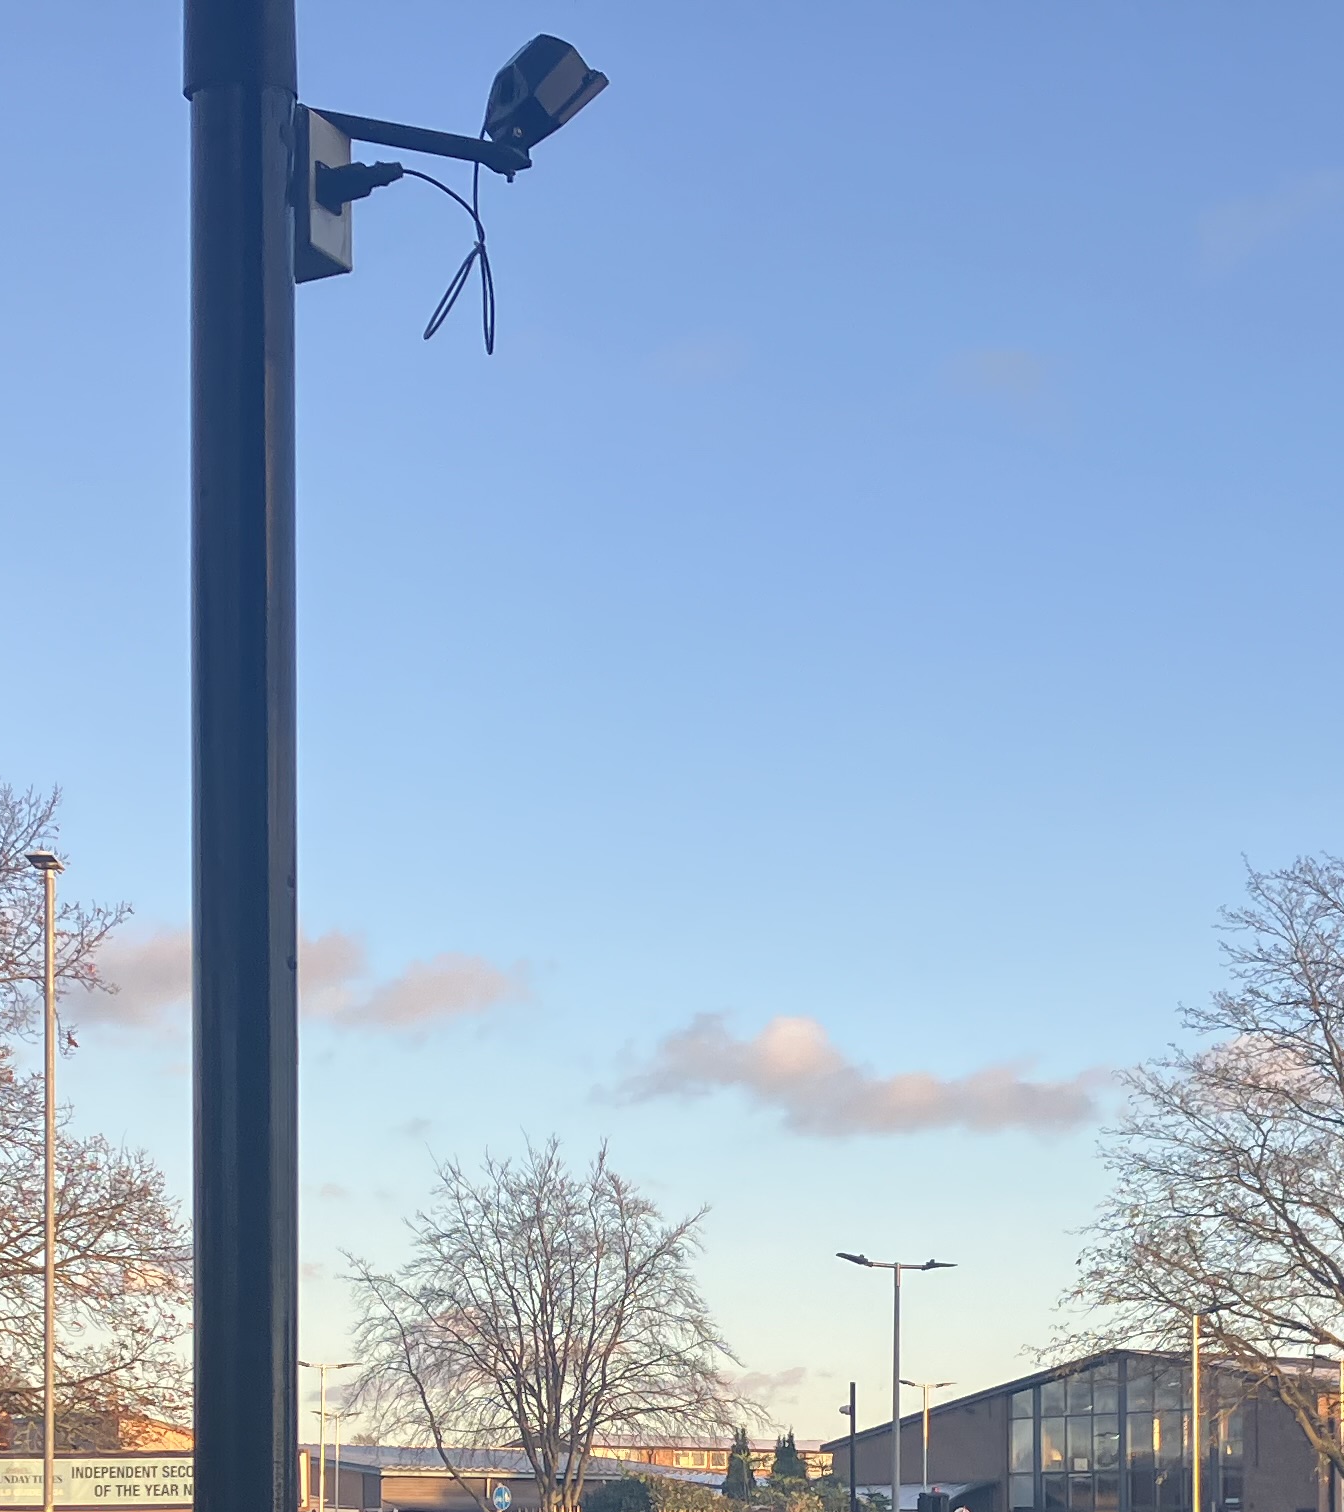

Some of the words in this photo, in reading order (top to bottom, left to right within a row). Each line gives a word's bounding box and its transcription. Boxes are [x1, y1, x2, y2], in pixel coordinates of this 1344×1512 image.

[71, 1466, 158, 1479] INDEPENDENT
[33, 1475, 63, 1484] TIES
[94, 1485, 112, 1498] OF
[116, 1484, 141, 1497] THE
[144, 1483, 179, 1497] YEAR
